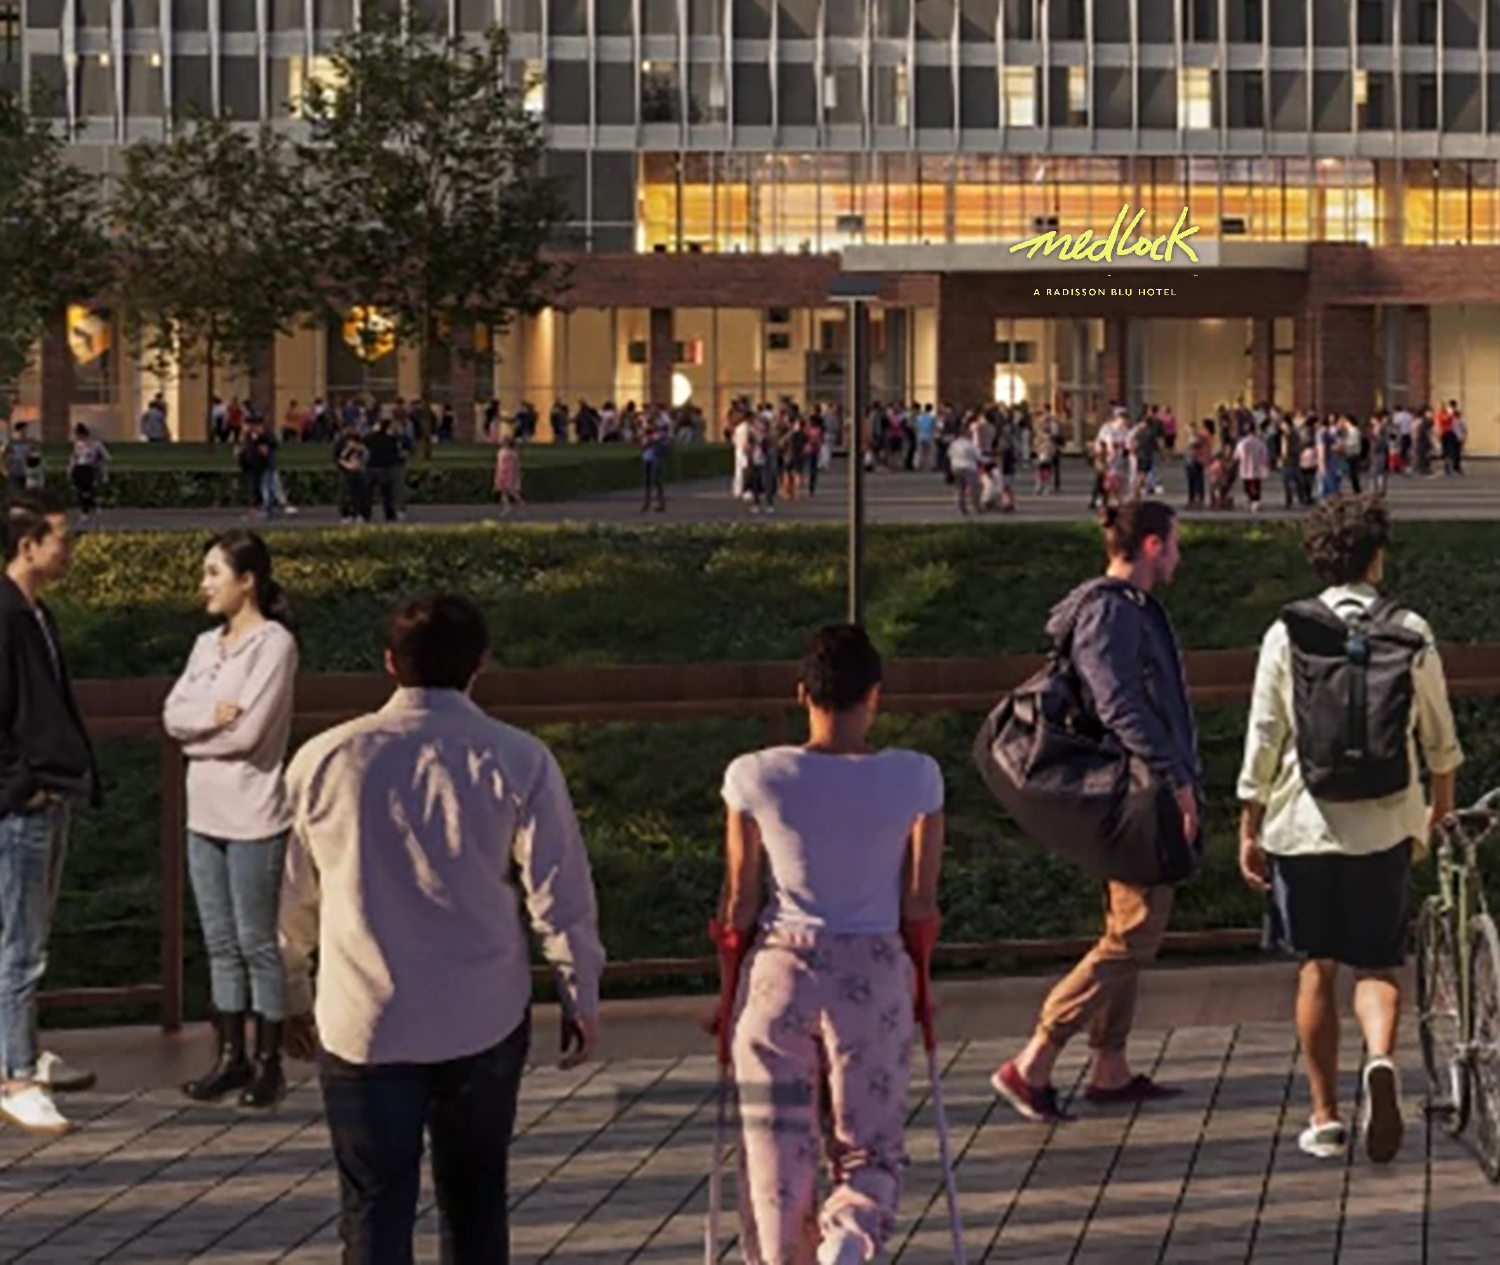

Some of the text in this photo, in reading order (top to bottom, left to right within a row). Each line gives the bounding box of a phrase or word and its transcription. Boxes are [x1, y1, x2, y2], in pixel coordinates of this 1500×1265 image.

[1009, 204, 1200, 263] medlock
[1033, 288, 1177, 297] A RADISSON BLU HOTEL
